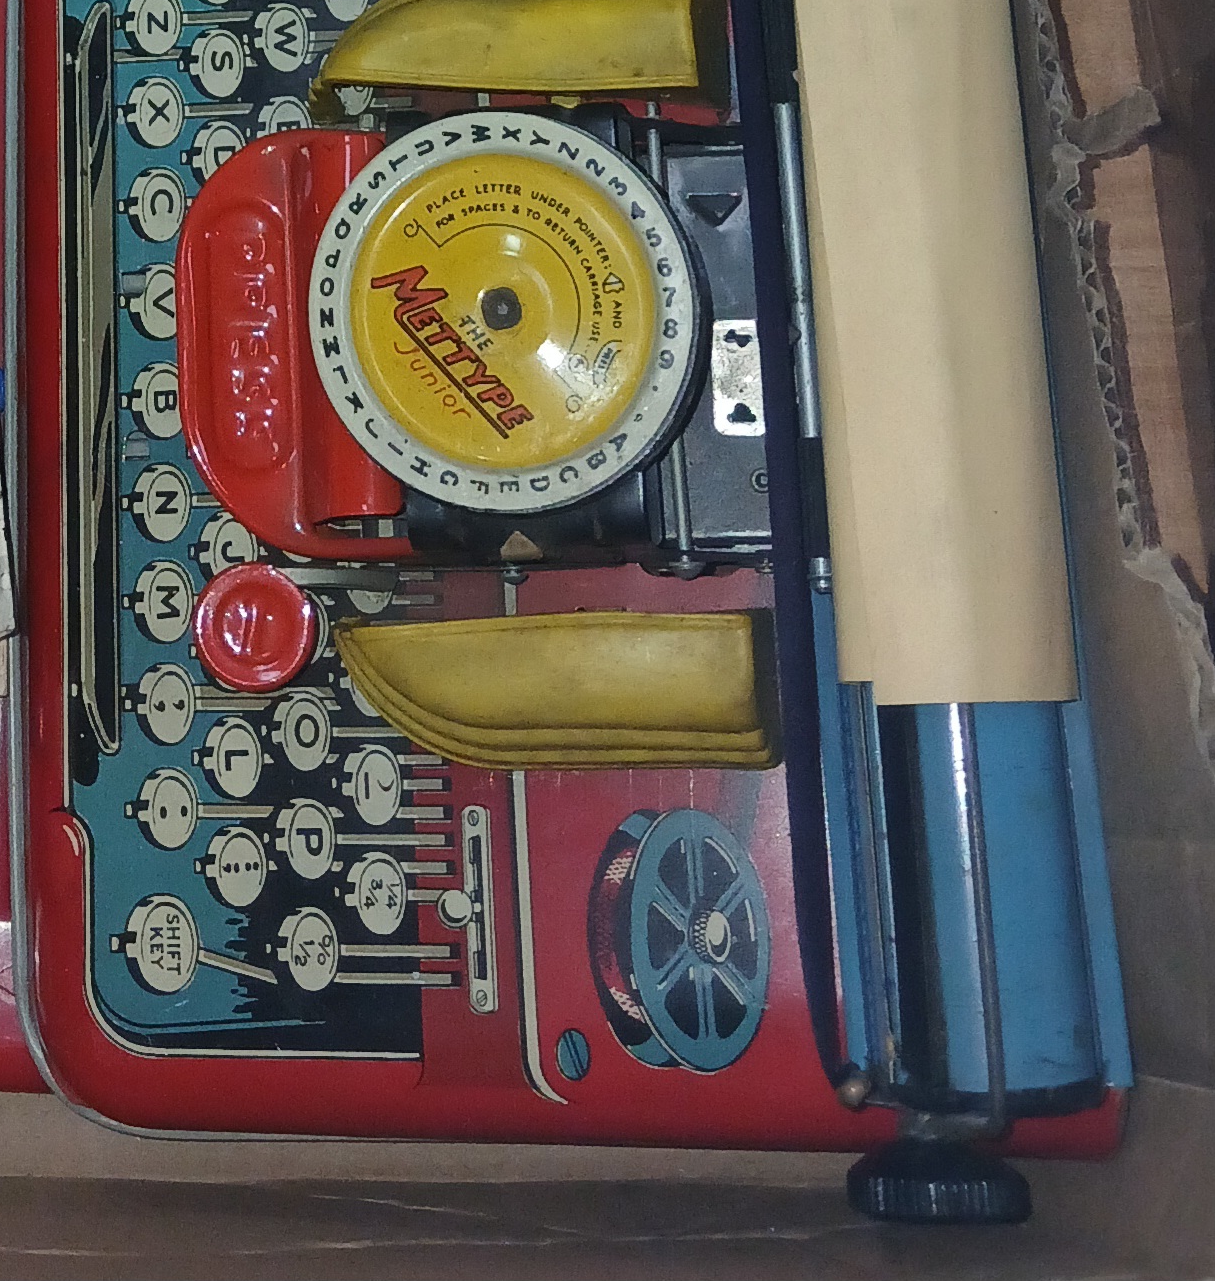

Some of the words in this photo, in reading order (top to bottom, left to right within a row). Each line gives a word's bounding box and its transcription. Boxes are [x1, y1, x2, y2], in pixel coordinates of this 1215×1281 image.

[147, 10, 168, 34] Z
[273, 19, 298, 58] W
[211, 50, 234, 72] S
[148, 98, 170, 126] X
[442, 131, 462, 147] V
[471, 124, 492, 144] W
[502, 126, 522, 143] X
[530, 130, 550, 146] Y
[415, 140, 435, 157] U
[558, 142, 580, 161] Z
[388, 154, 409, 172] T
[586, 159, 606, 178] 2
[368, 172, 387, 189] S
[608, 177, 628, 196] 3
[150, 188, 174, 215] C
[349, 193, 369, 216] R
[631, 201, 646, 220] 4
[646, 227, 662, 248] 5
[325, 249, 342, 269] P
[426, 187, 467, 214] PLACE
[474, 183, 522, 197] LETTER
[530, 190, 571, 218] UNDER
[573, 216, 613, 270] POINTER:
[612, 299, 623, 329] AND
[435, 213, 456, 229] FOR
[461, 202, 506, 217] SPACES
[511, 204, 520, 215] &
[526, 207, 541, 221] TO
[544, 217, 584, 255] RETURN
[580, 257, 604, 317] CARRIAGE
[657, 258, 672, 278] 6
[320, 277, 335, 297] O
[662, 287, 676, 308] 7
[152, 288, 175, 318] V
[320, 308, 335, 328] N
[458, 314, 495, 352] THE
[663, 319, 679, 339] 8
[322, 336, 340, 358] M
[371, 265, 535, 431] METTYPE
[659, 349, 675, 370] 9
[393, 341, 473, 420] Junior
[153, 390, 178, 413] B
[345, 391, 364, 415] K
[608, 433, 628, 452] A
[410, 456, 431, 477] H
[586, 450, 606, 470] B
[440, 470, 459, 487] G
[530, 475, 550, 492] D
[559, 465, 579, 484] C
[470, 479, 490, 495] F
[499, 479, 519, 494] E
[155, 491, 179, 514] N
[156, 585, 180, 619] M
[294, 713, 320, 748] O
[224, 749, 250, 771] L
[296, 827, 324, 856] P
[363, 878, 384, 911] 3/4
[149, 926, 165, 970] KEY
[166, 913, 182, 976] SHIFT
[294, 939, 316, 967] 1/2
